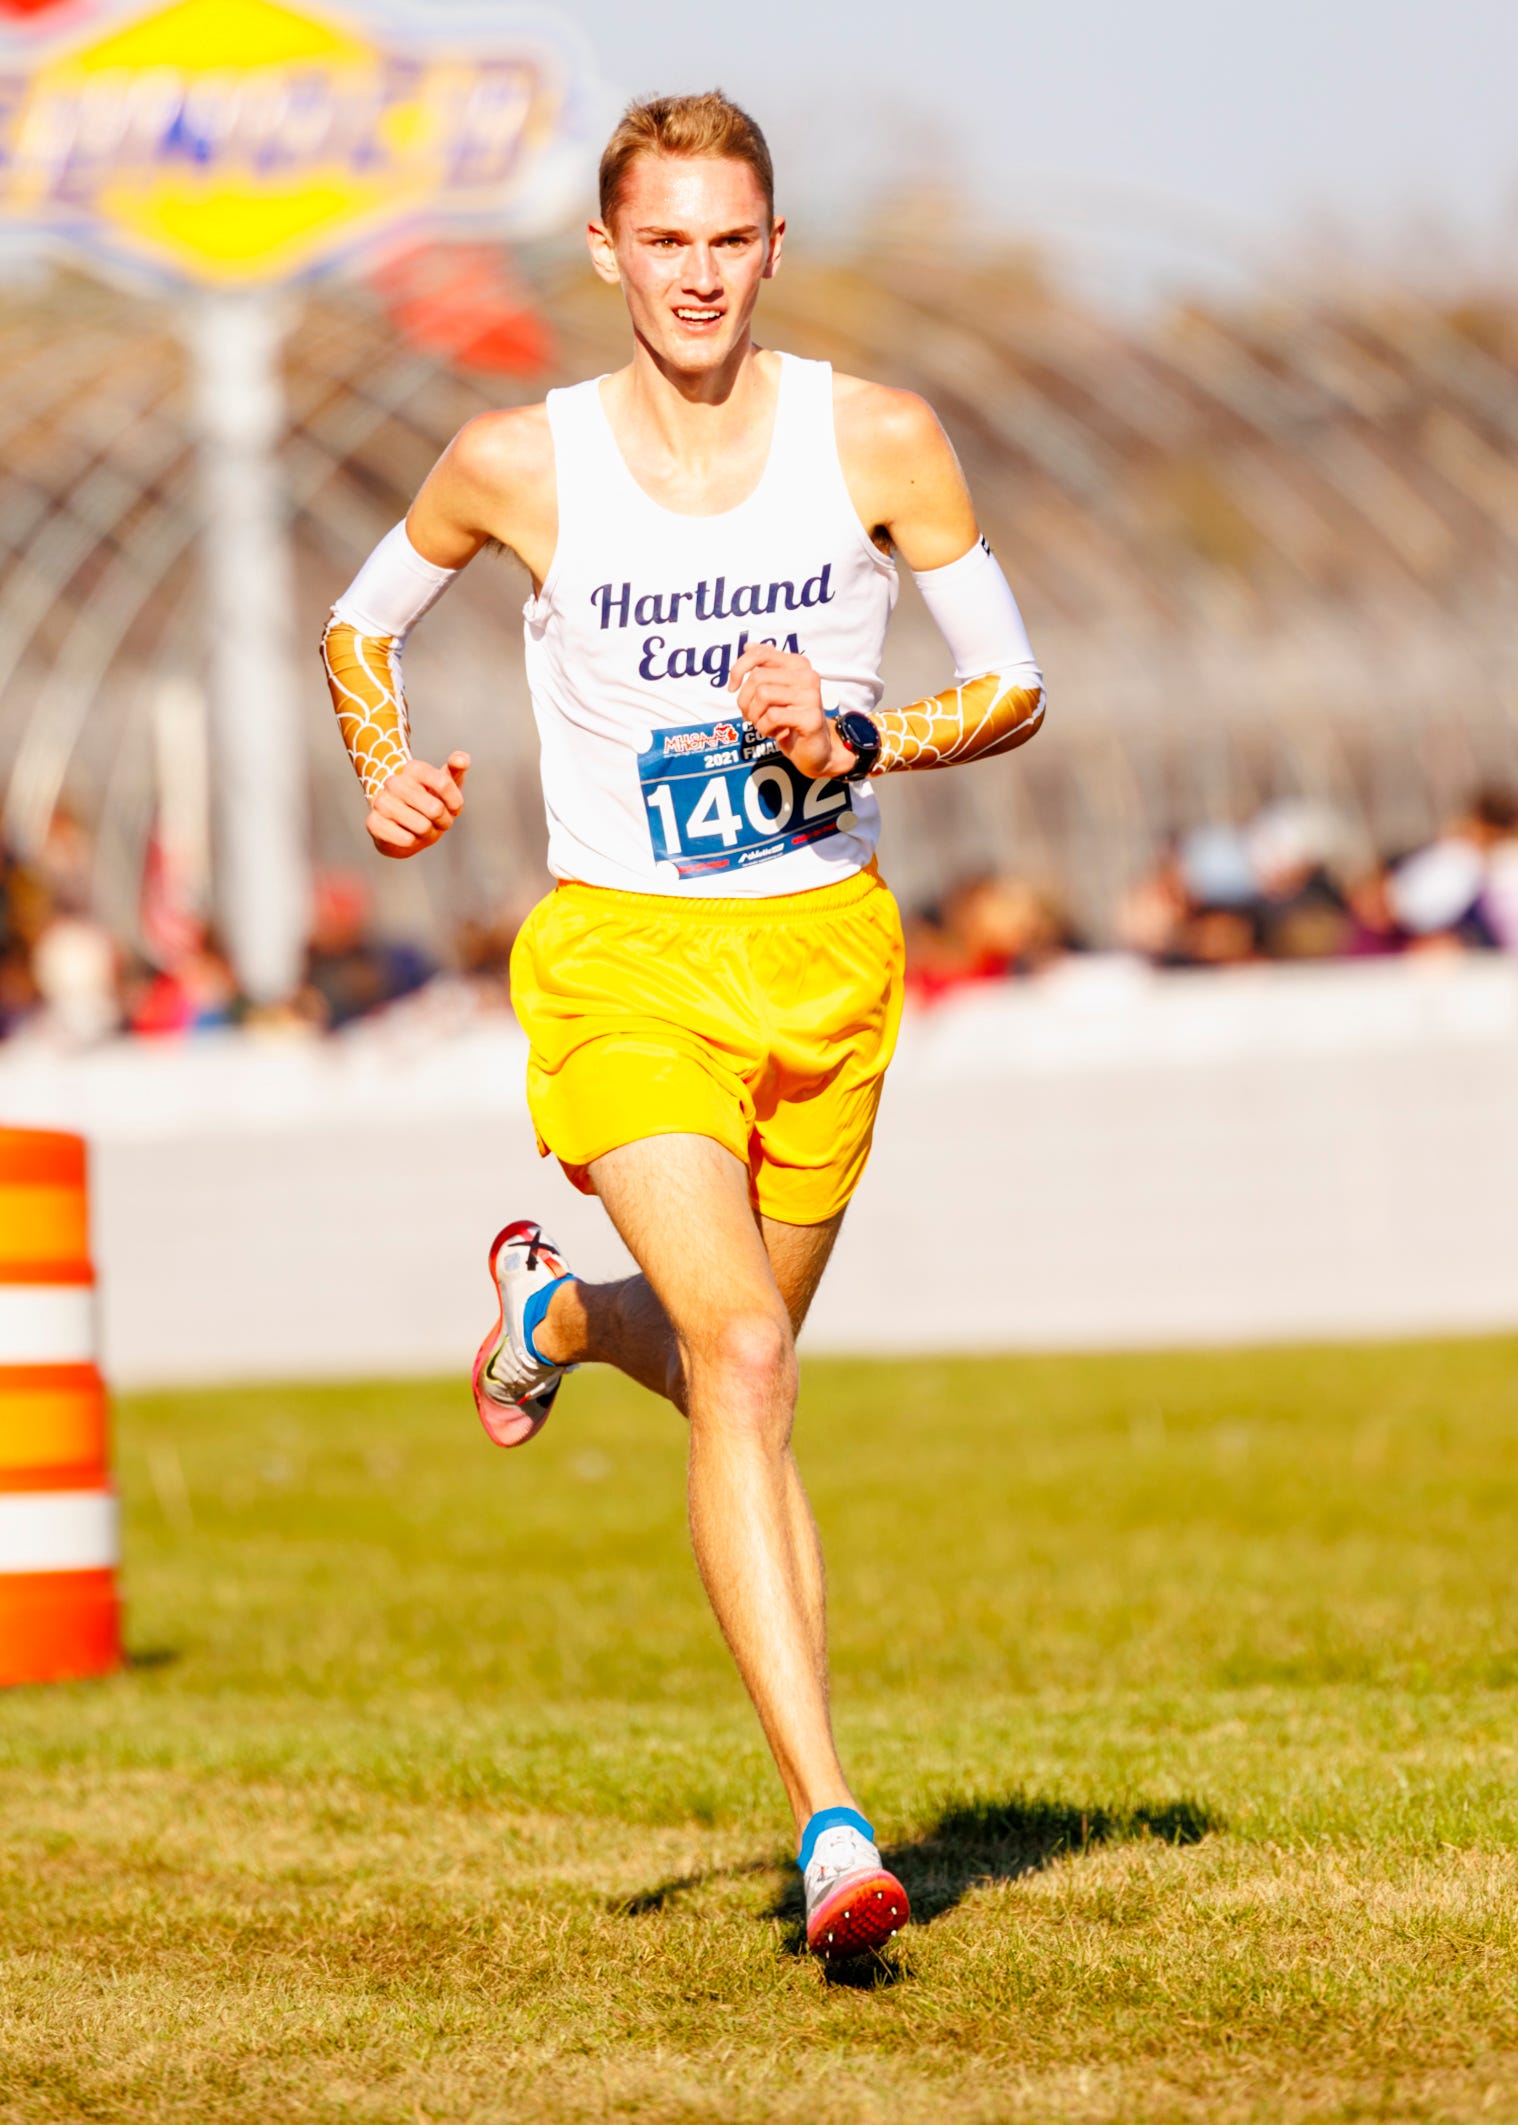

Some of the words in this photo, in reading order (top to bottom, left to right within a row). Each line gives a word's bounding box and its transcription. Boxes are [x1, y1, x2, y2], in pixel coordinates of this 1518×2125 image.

[590, 563, 836, 629] Hartland
[703, 749, 740, 769] 2021
[646, 765, 847, 855] 1402
